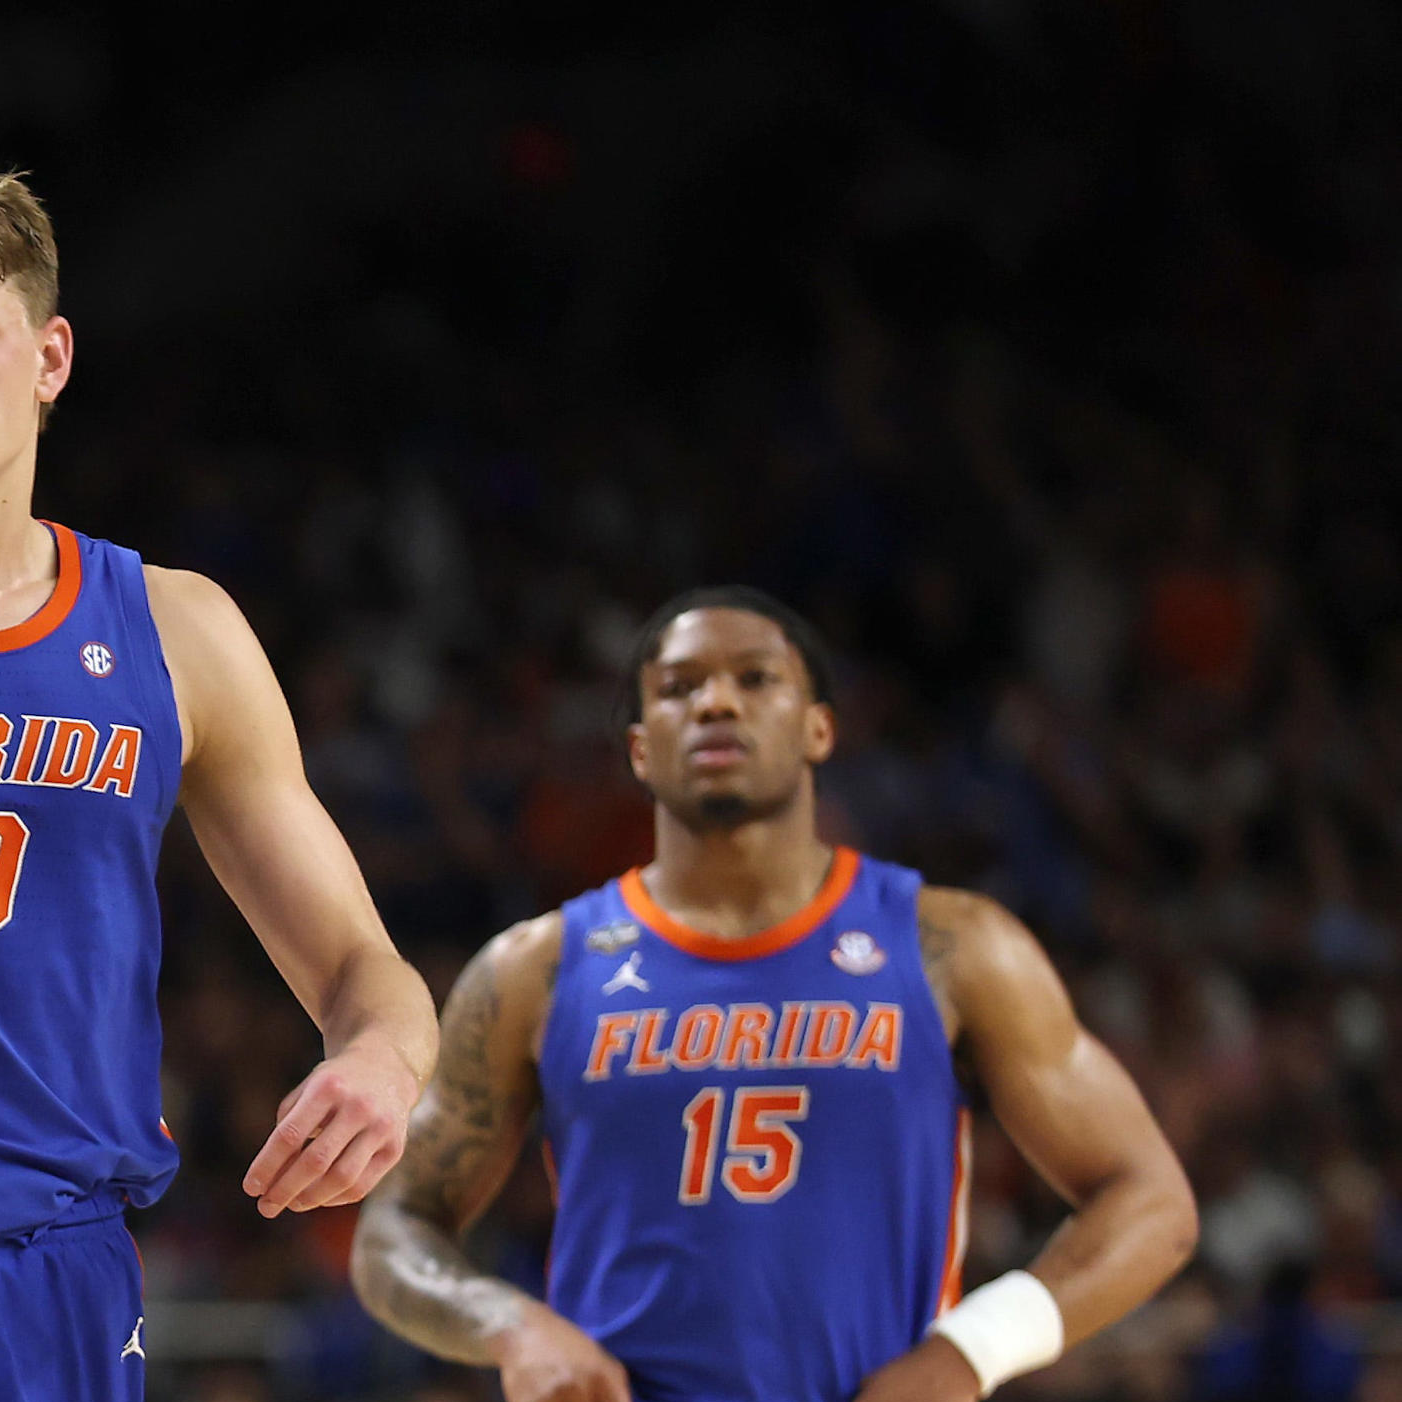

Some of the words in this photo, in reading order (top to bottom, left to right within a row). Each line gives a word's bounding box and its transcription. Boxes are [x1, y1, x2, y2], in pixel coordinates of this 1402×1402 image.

[82, 643, 112, 674] SEC
[583, 1002, 902, 1081] FLORIDA
[677, 1085, 810, 1206] 15
